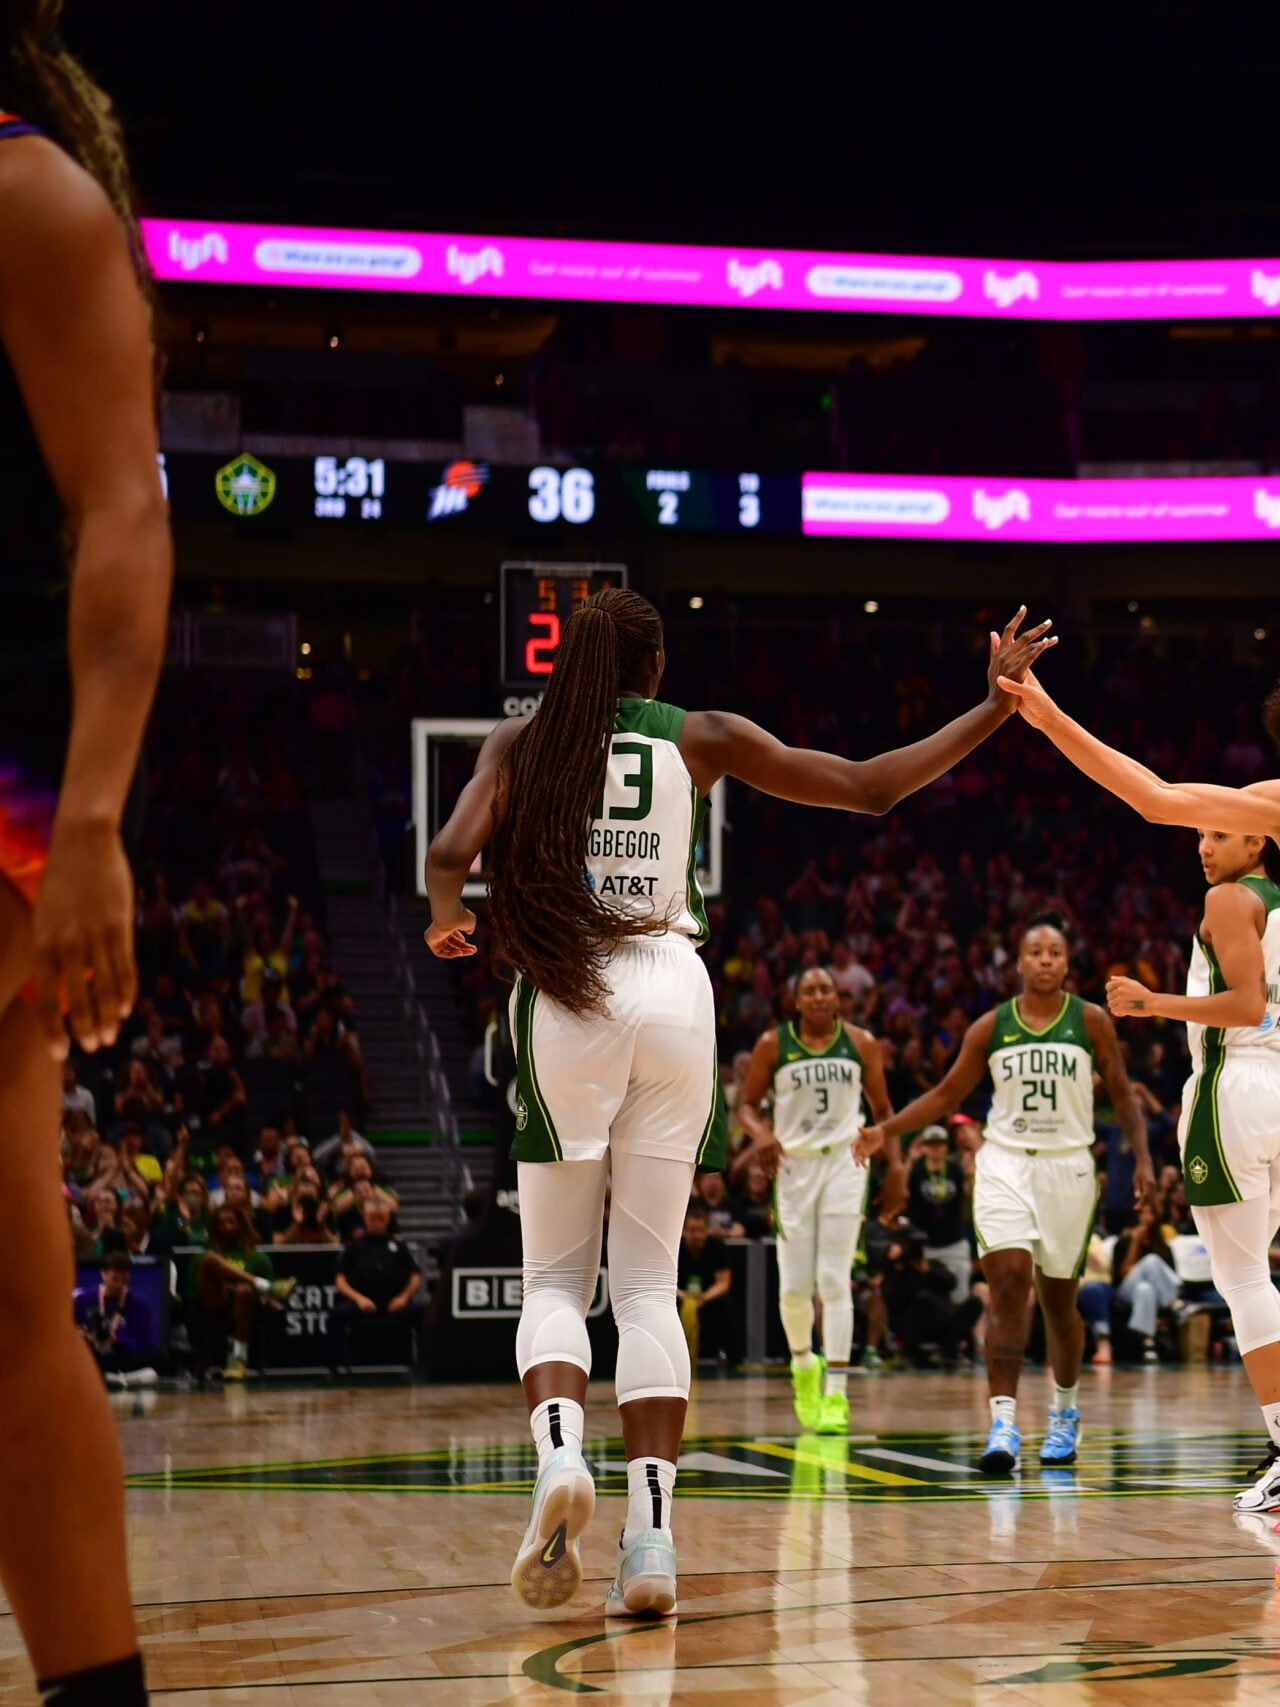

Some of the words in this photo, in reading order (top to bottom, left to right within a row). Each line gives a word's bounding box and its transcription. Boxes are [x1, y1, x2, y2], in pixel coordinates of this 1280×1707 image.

[314, 456, 384, 497] 5:31
[528, 466, 594, 523] 36
[658, 491, 678, 524] 2
[739, 493, 760, 527] 3
[586, 829, 660, 860] GBEGOR
[600, 875, 659, 897] AT&T
[791, 1063, 853, 1091] STORM
[1002, 1049, 1077, 1082] STORM
[814, 1088, 829, 1115] 3
[1022, 1080, 1056, 1111] 24
